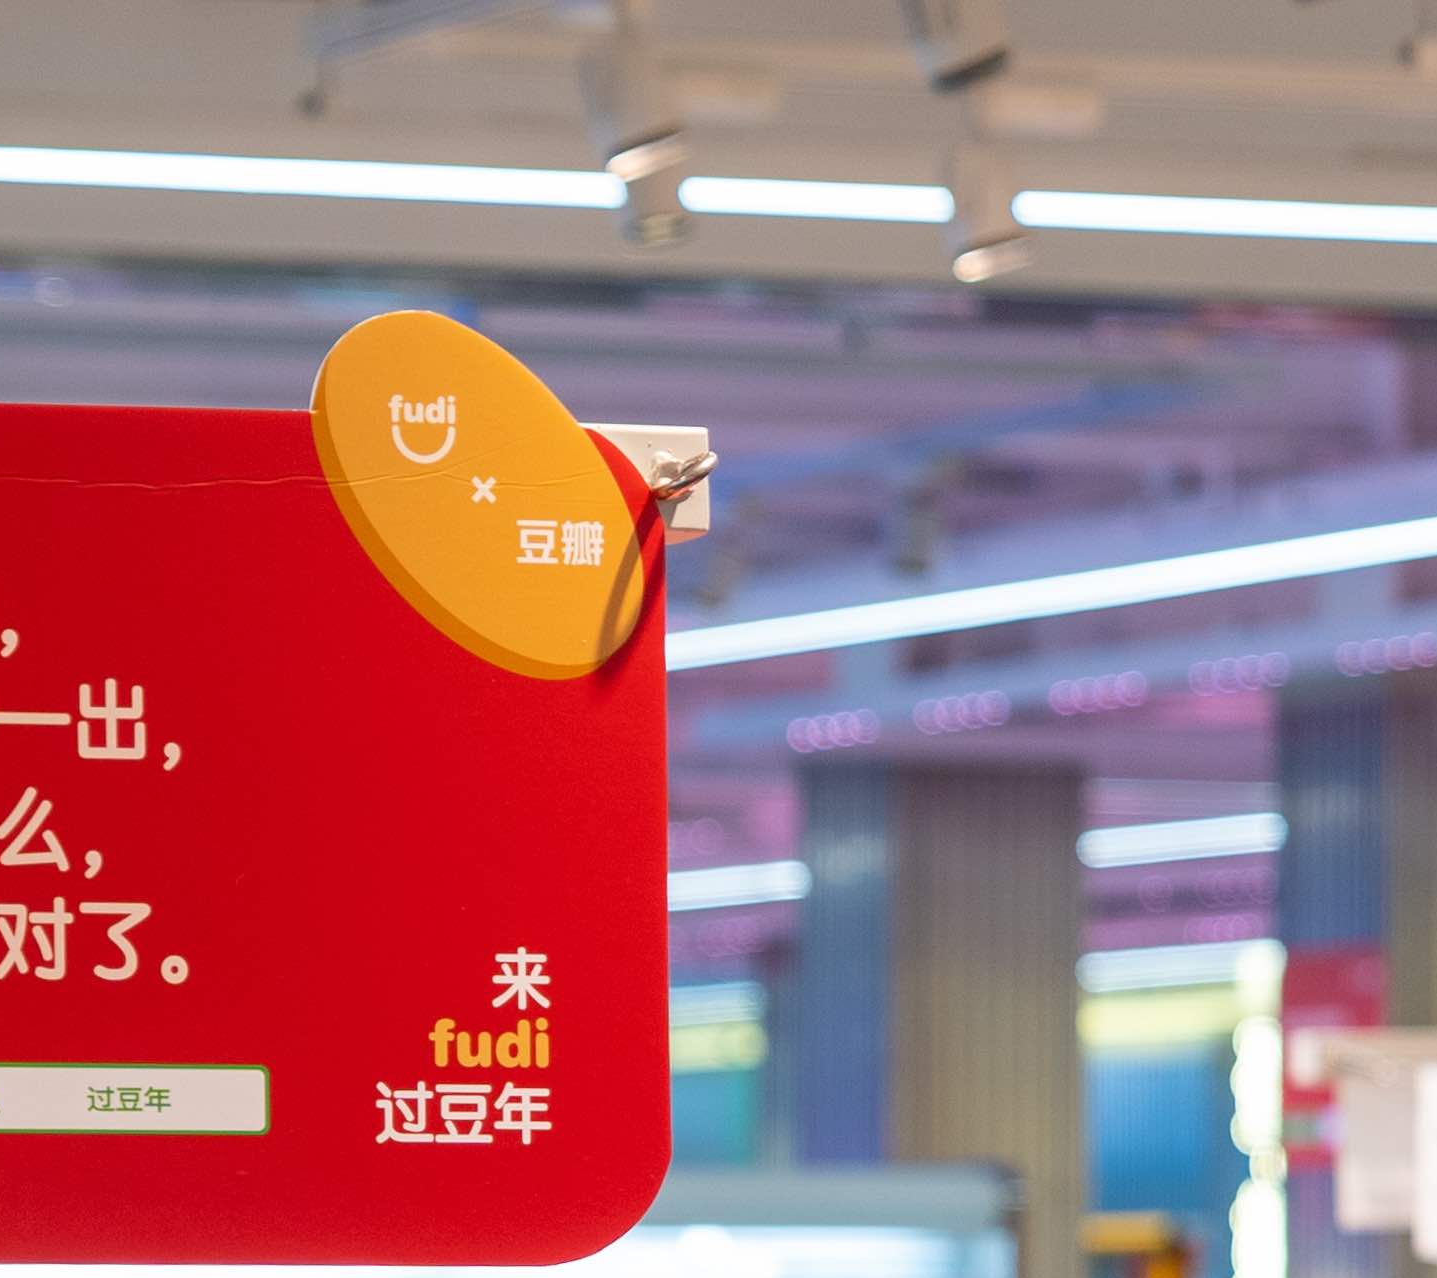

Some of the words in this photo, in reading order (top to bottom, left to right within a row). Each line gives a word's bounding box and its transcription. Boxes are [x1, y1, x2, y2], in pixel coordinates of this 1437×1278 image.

[389, 395, 457, 425] fudi
[516, 519, 605, 567] 豆瓣
[492, 949, 552, 1010] 来
[430, 1018, 551, 1068] fudi
[87, 1086, 172, 1113] 过豆年
[376, 1082, 553, 1146] 过豆年
